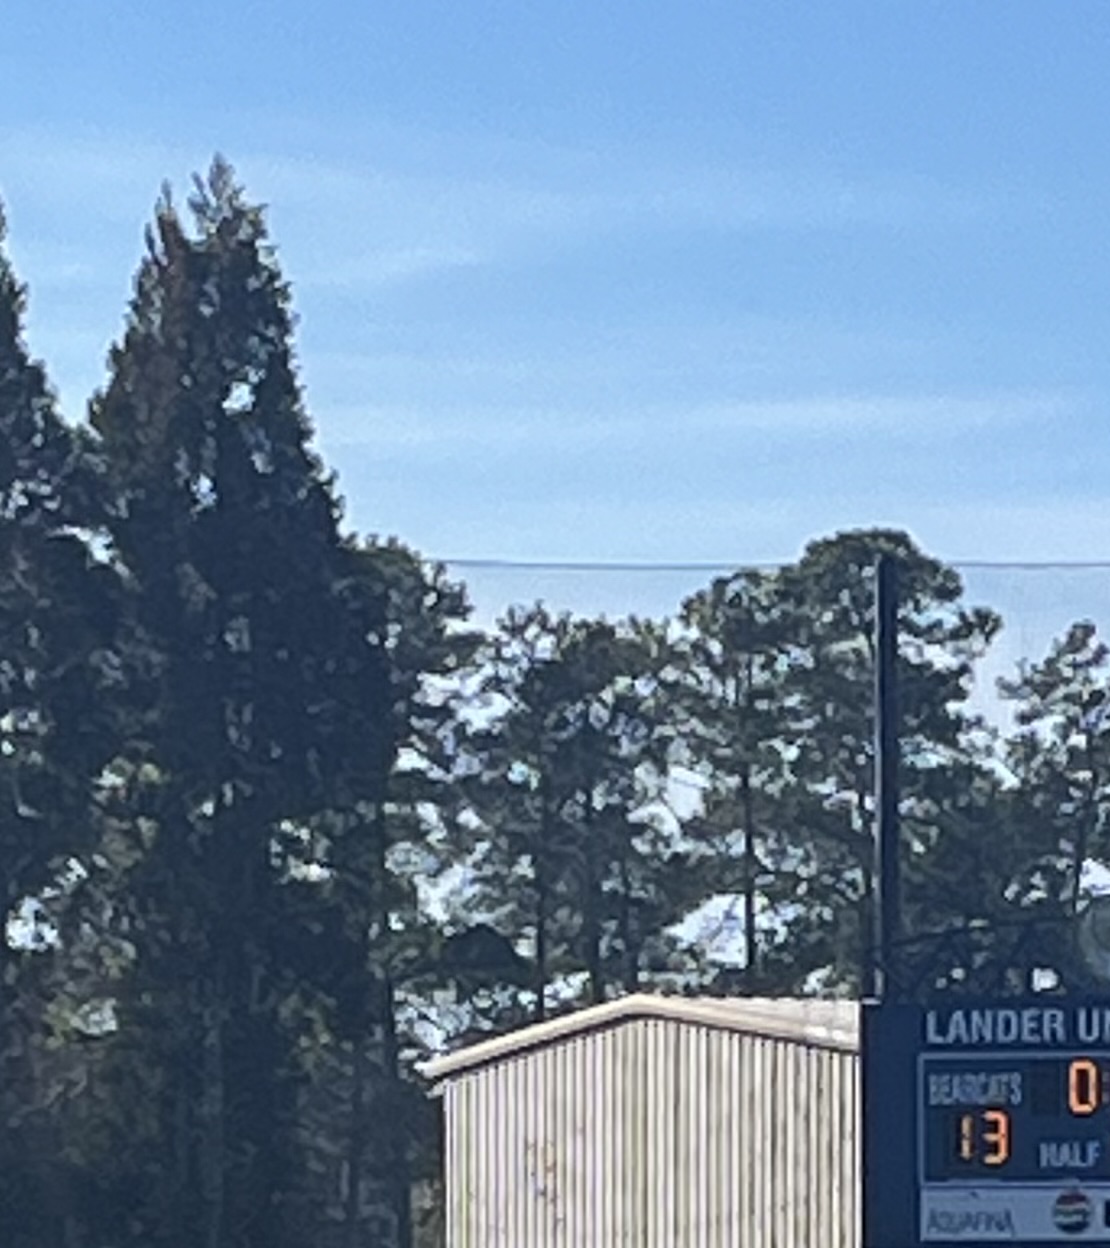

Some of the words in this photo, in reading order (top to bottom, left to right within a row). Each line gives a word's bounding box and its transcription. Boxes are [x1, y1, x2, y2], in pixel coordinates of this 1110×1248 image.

[926, 1008, 1065, 1044] LANDER
[961, 1110, 1008, 1164] 13
[1039, 1140, 1100, 1168] HALF
